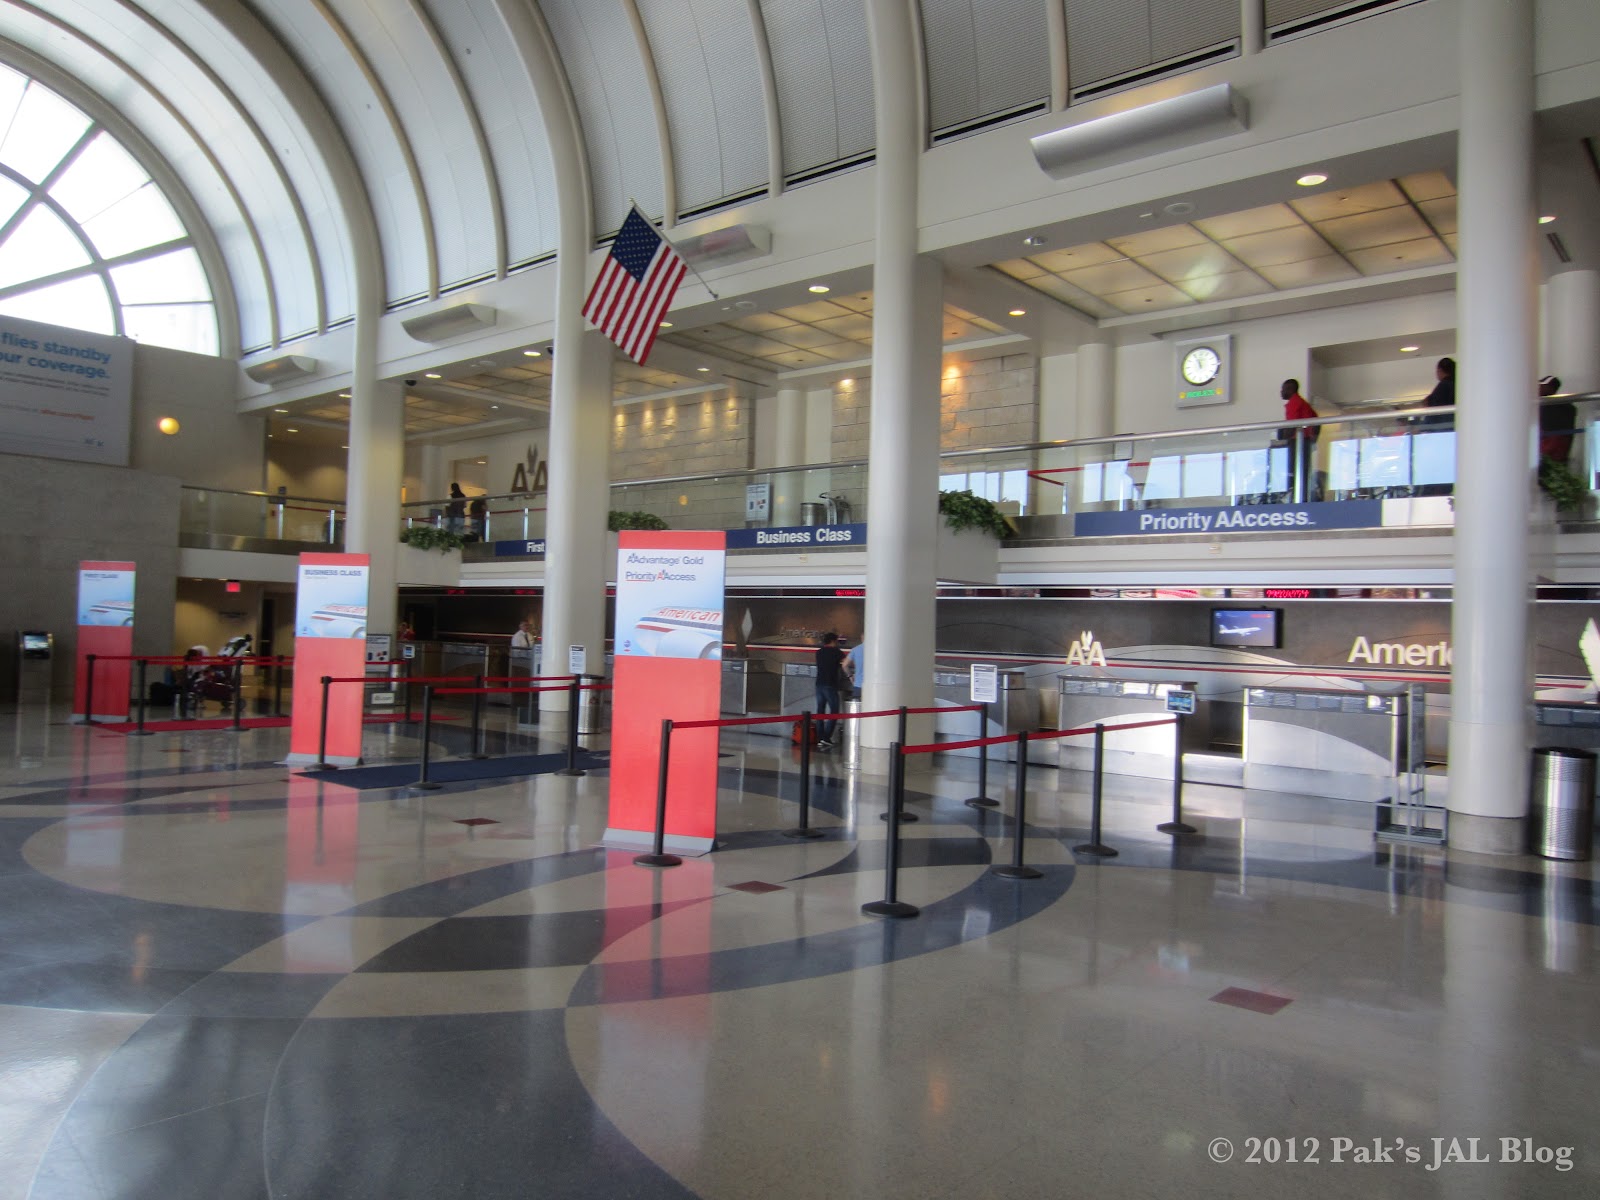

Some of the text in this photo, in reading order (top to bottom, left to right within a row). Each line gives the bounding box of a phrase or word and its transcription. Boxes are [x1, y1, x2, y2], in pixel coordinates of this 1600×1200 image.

[1, 332, 112, 364] flies standby
[27, 357, 110, 378] coverage.
[1139, 510, 1309, 532] Priority AAccess
[756, 528, 852, 545] Business Class
[526, 541, 546, 553] First
[682, 556, 704, 565] Gold
[625, 571, 656, 582] Priority
[657, 608, 721, 621] American
